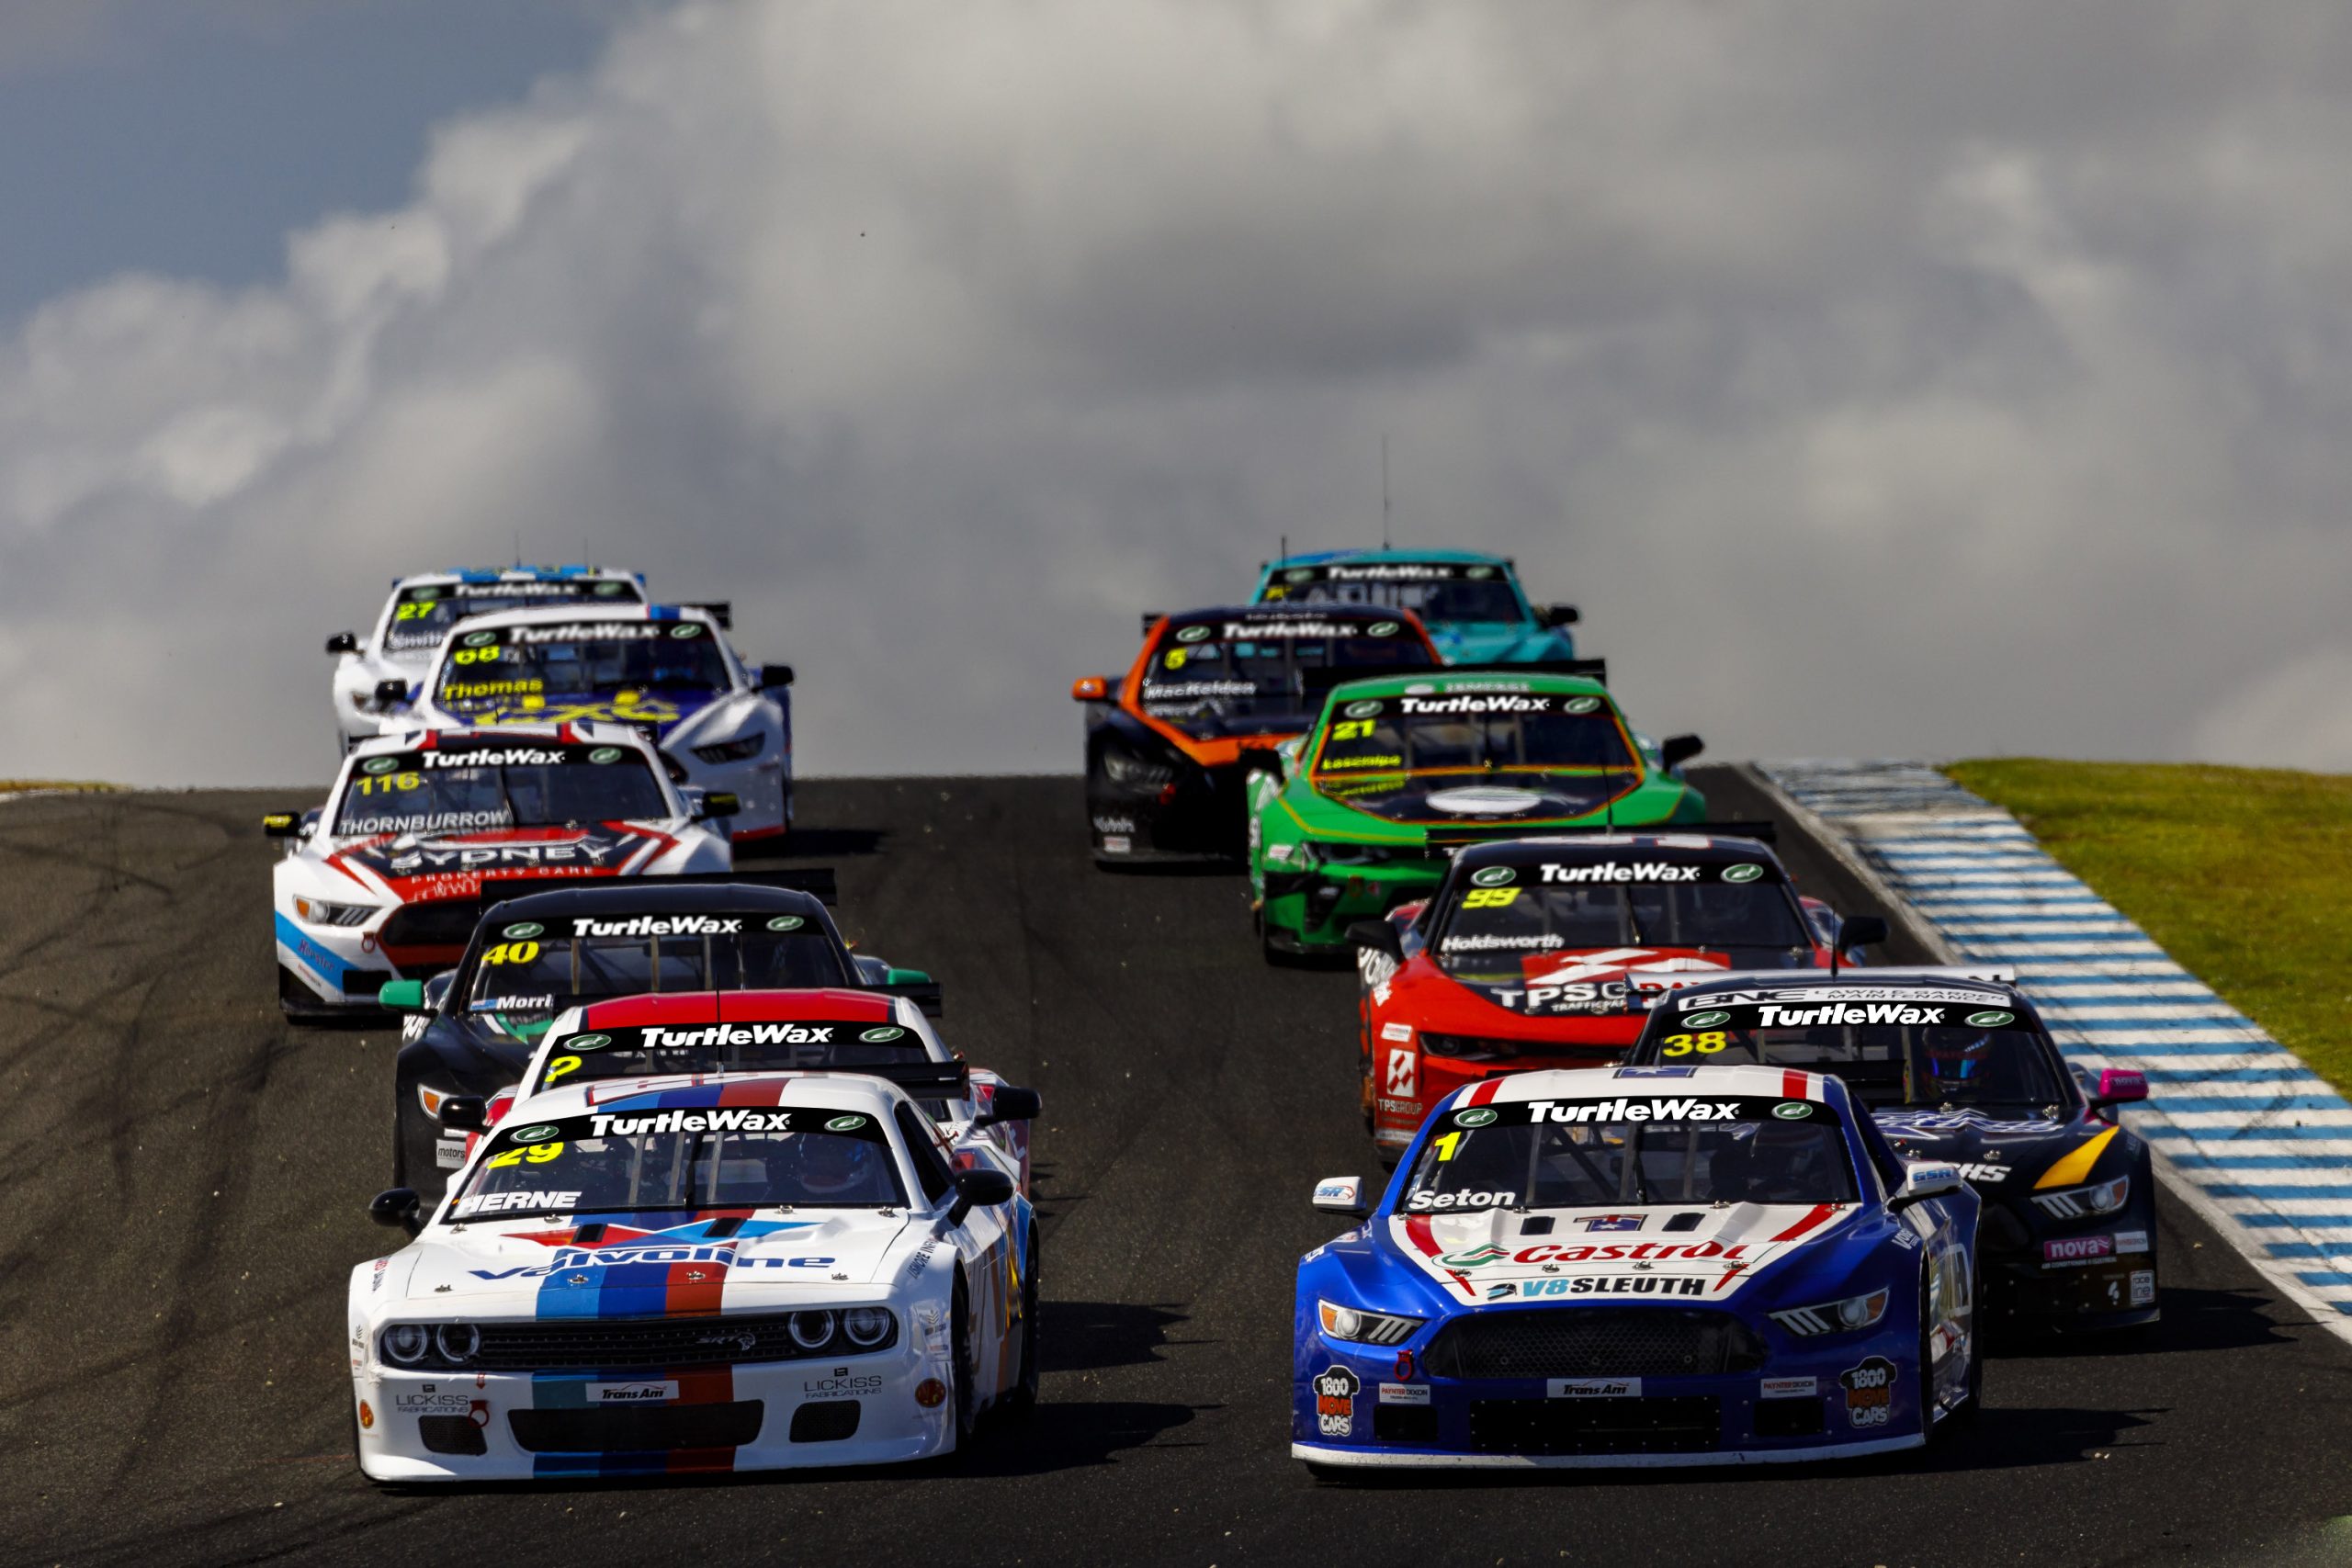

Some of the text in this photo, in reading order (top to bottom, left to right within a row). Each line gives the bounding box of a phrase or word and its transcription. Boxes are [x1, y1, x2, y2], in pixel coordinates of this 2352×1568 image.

[396, 602, 436, 621] 27
[454, 645, 501, 665] 68
[1164, 648, 1188, 670] 5
[443, 678, 544, 701] Thomas
[1332, 719, 1375, 740] 21
[356, 773, 420, 795] 116
[340, 811, 506, 835] THORNBURROW
[1461, 887, 1522, 908] 99
[481, 942, 539, 965] 40
[1440, 933, 1565, 953] Holdsworth
[496, 994, 554, 1010] Morri
[1758, 1003, 1945, 1026] TurtleWax
[641, 1023, 831, 1047] TurtleWax
[1663, 1031, 1726, 1057] 38
[1528, 1100, 1740, 1122] TurtleWax
[590, 1110, 787, 1136] TurtleWax
[487, 1142, 564, 1169] 29
[1434, 1131, 1462, 1161] 1
[454, 1191, 582, 1214] HERNE
[1408, 1189, 1516, 1210] Seton
[1513, 1240, 1750, 1264] Castrol
[2051, 1240, 2098, 1258] nova
[804, 1375, 882, 1392] LICKISS
[1320, 1377, 1349, 1396] 1800
[1852, 1368, 1885, 1388] 1800
[395, 1394, 469, 1406] LICKISS
[1318, 1395, 1351, 1416] MOVE
[1848, 1387, 1890, 1407] MOVE
[1320, 1415, 1351, 1434] CARS
[1851, 1406, 1888, 1425] CARS
